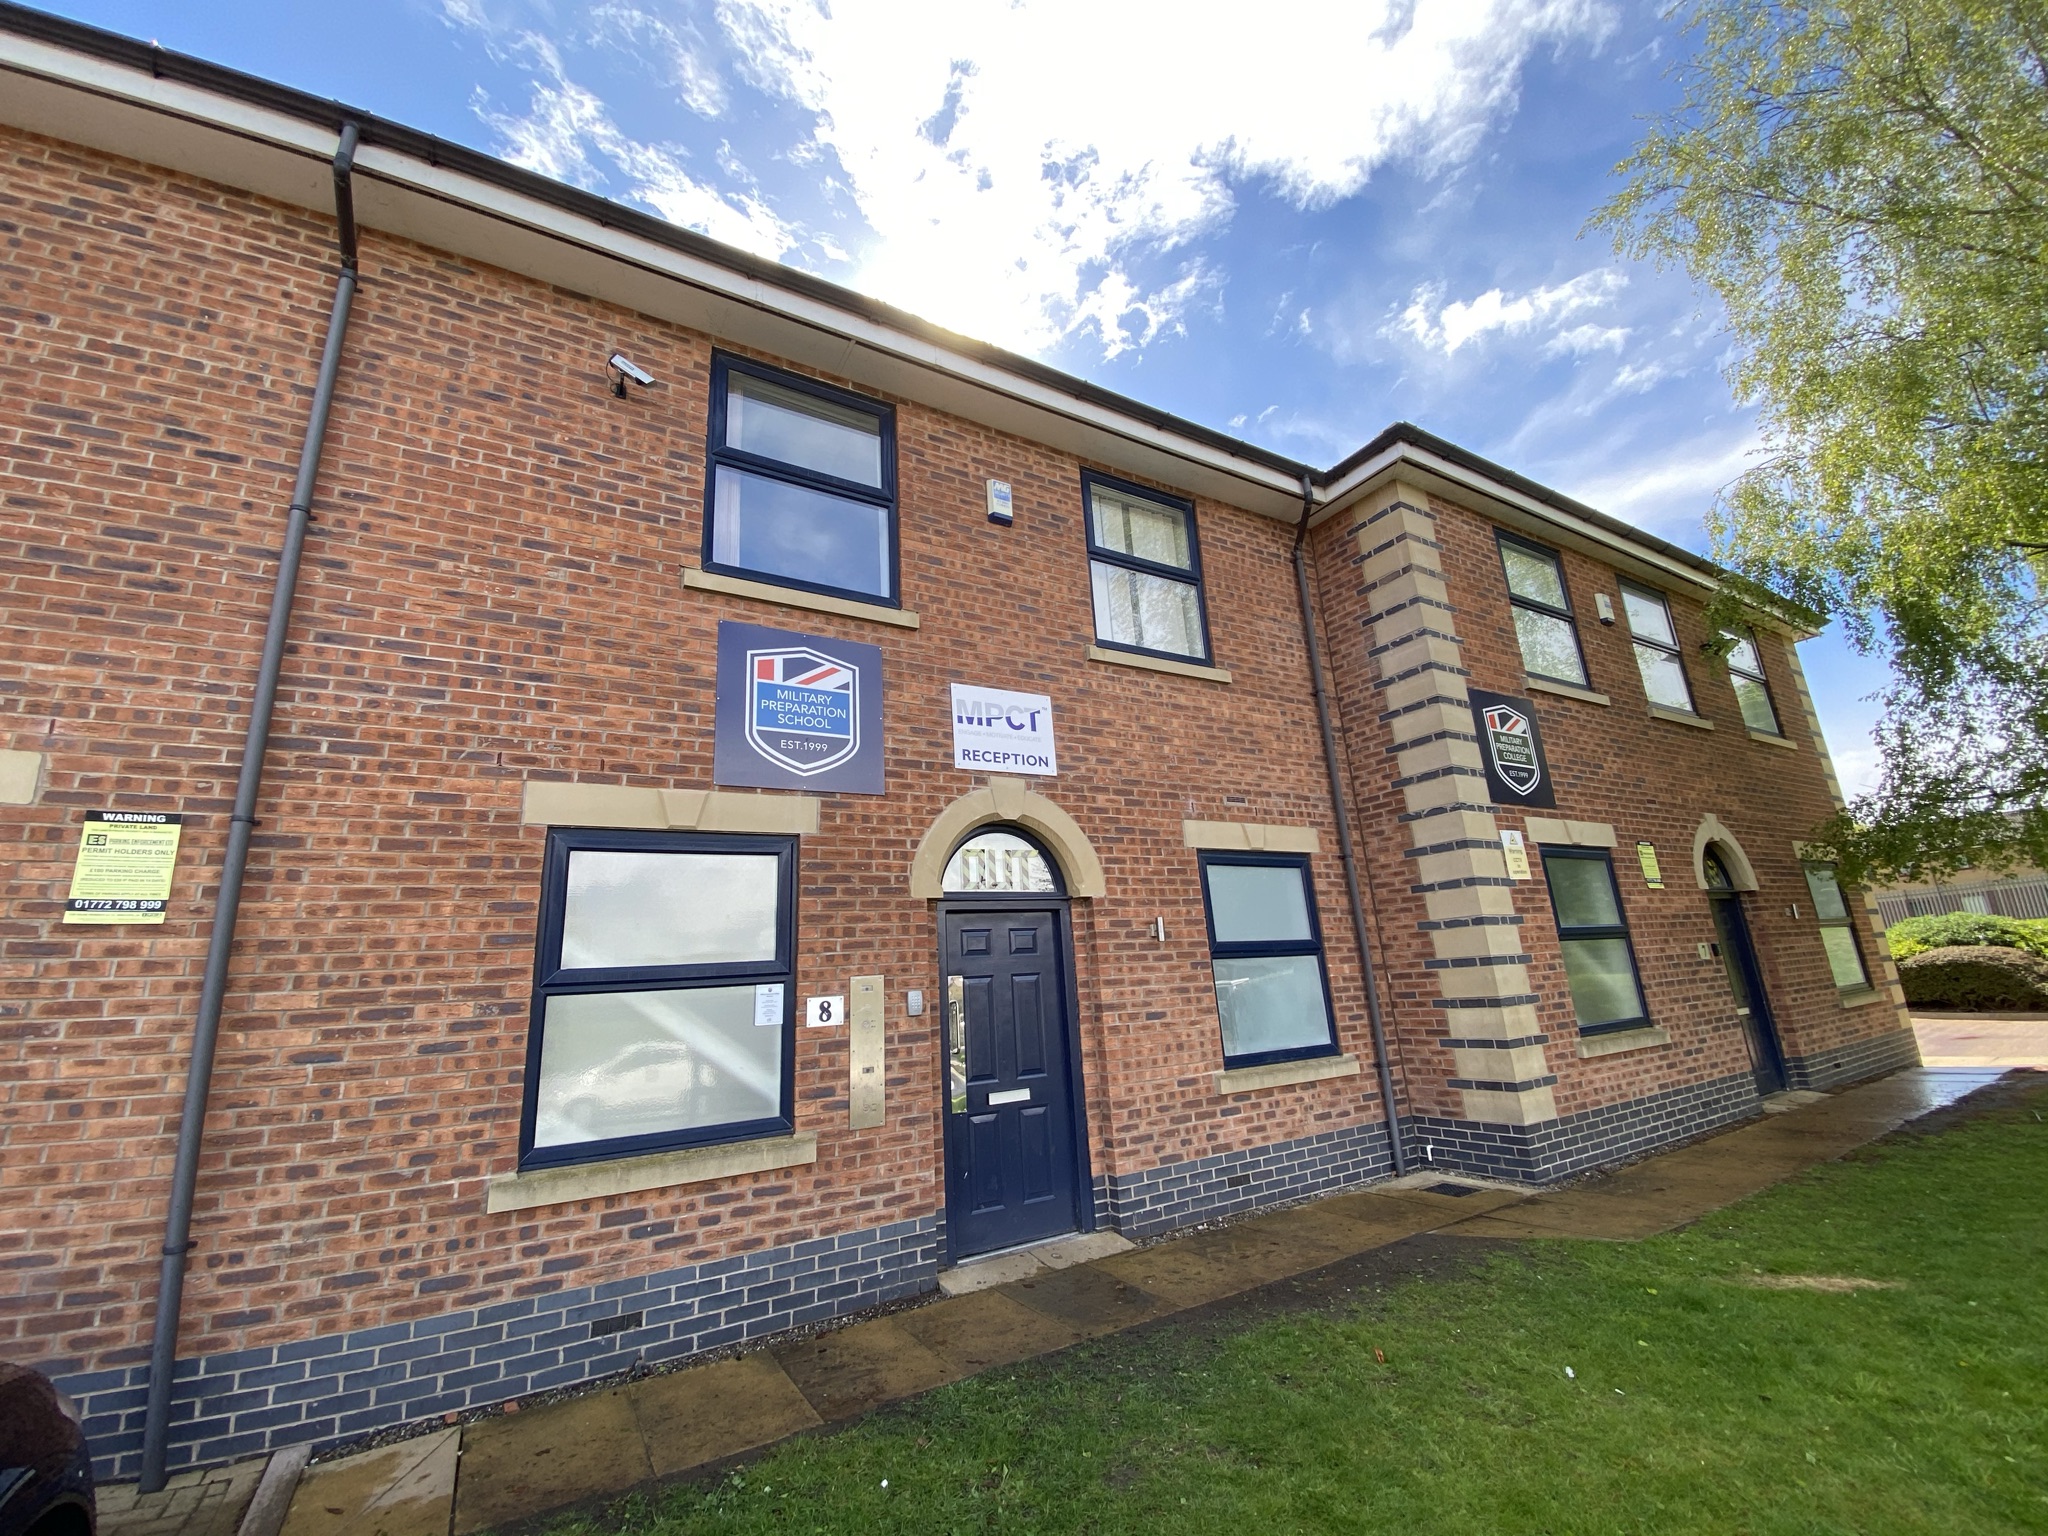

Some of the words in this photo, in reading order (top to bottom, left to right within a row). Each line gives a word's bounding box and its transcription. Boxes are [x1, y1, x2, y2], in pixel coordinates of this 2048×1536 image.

[776, 689, 833, 705] MILITARY
[761, 700, 847, 719] PREPARATION
[956, 698, 1041, 732] MPCT
[777, 713, 832, 729] SCHOOL
[780, 739, 828, 752] EST.1999
[1499, 735, 1523, 745] MILITARY
[1496, 742, 1530, 755] PREPARATION
[962, 748, 1049, 768] RECEPTION
[1503, 752, 1527, 763] COLLEGE
[102, 812, 166, 823] WARNING
[88, 835, 106, 845] ES
[114, 848, 153, 856] HOLDERS
[75, 899, 112, 908] 01772
[115, 900, 137, 909] 798
[140, 900, 162, 909] 999
[818, 1000, 832, 1023] 8
